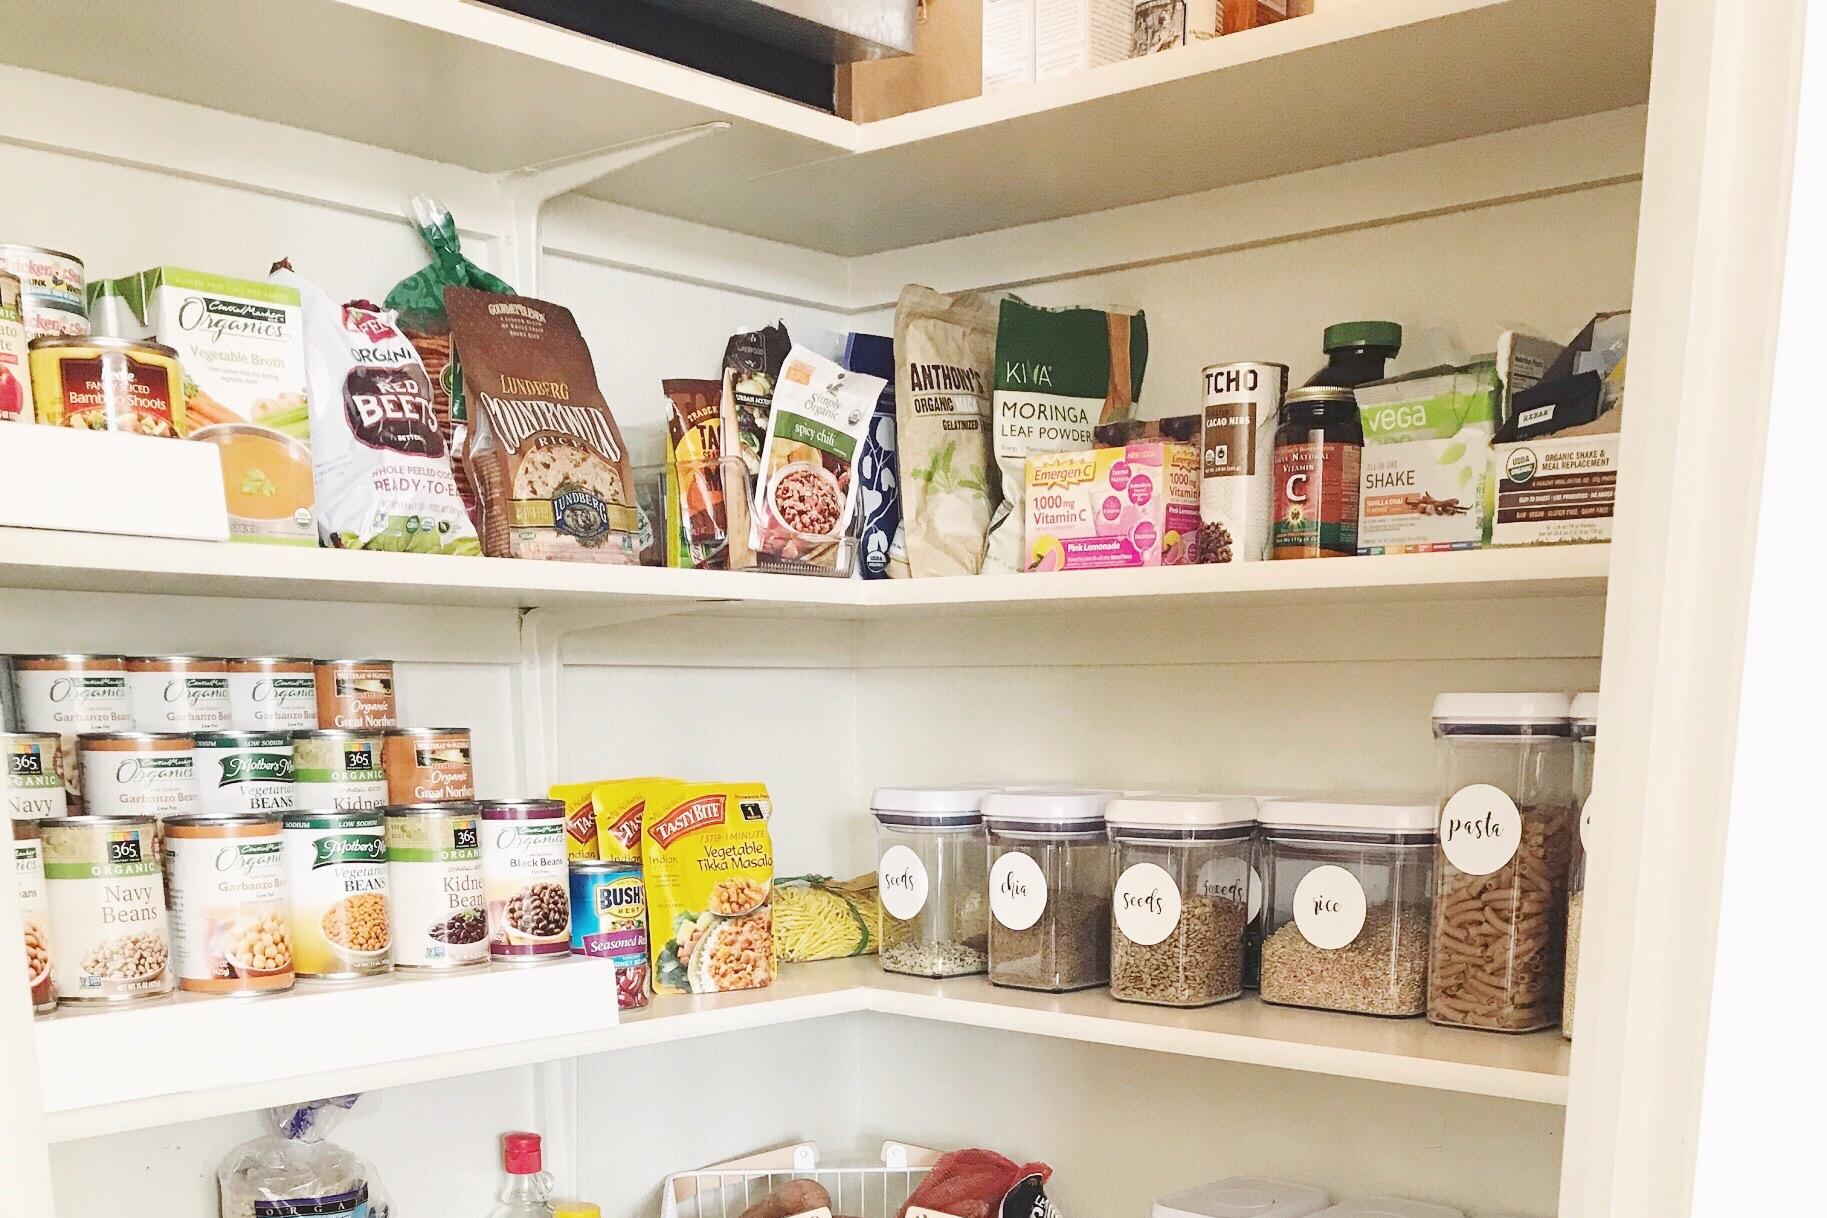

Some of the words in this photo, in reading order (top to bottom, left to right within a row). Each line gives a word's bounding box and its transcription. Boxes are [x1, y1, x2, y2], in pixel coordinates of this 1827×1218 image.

[178, 296, 283, 342] Organics
[191, 345, 248, 366] Vegetable
[251, 351, 285, 368] Broth
[911, 362, 984, 395] ANTHONY'S
[1006, 361, 1053, 387] KIVA
[1205, 369, 1258, 395] TCHO
[377, 380, 419, 394] RED
[500, 374, 570, 400] LUNDBERG
[352, 395, 438, 432] BEETS
[803, 400, 840, 421] Organic
[914, 396, 953, 414] ORGANIC
[1002, 401, 1089, 425] MORINGA
[1206, 416, 1227, 428] CACAO
[1229, 415, 1250, 425] NIBS
[794, 422, 816, 439] spicy
[816, 427, 836, 445] chili
[1001, 424, 1034, 438] LEAF
[1039, 428, 1093, 444] POWDER
[538, 435, 584, 451] RICE
[1542, 461, 1560, 470] MEAL
[1561, 458, 1610, 470] REPLACEMENT
[1545, 453, 1574, 462] ORGANIC
[1575, 450, 1599, 460] SHAKE
[1285, 474, 1308, 503] C
[1366, 470, 1416, 489] SHAKE
[555, 490, 608, 523] LUNDBERG
[1063, 499, 1075, 509] mg
[1033, 511, 1077, 525] Vitamin
[1079, 509, 1087, 522] C
[1067, 541, 1083, 552] Pink
[1083, 538, 1120, 552] Lemonade
[350, 700, 389, 713] Organic
[334, 714, 364, 728] Great
[261, 739, 285, 747] SODIUM
[12, 754, 38, 772] 365
[349, 751, 370, 768] 365
[331, 770, 384, 781] ORGANIC
[431, 770, 468, 785] Organic
[415, 786, 444, 799] Great
[250, 794, 294, 810] BEANS
[338, 820, 354, 828] LOW
[354, 819, 378, 828] SODIUM
[1447, 811, 1503, 842] pasta
[457, 831, 476, 845] 365
[112, 842, 139, 860] 365
[704, 842, 763, 859] Vegetable
[91, 862, 155, 876] ORGANIC
[509, 857, 538, 868] Black
[540, 857, 564, 867] Beans
[697, 858, 728, 871] Tikka
[731, 854, 773, 869] Masala
[217, 879, 273, 892] Garbanzo
[344, 879, 386, 893] BEANS
[885, 866, 915, 892] seeds
[1001, 870, 1028, 898] chia
[105, 885, 152, 905] Navy
[1123, 888, 1164, 915] seeds
[1312, 894, 1341, 916] rice
[102, 905, 158, 924] Beans
[590, 936, 637, 954] Seasoned
